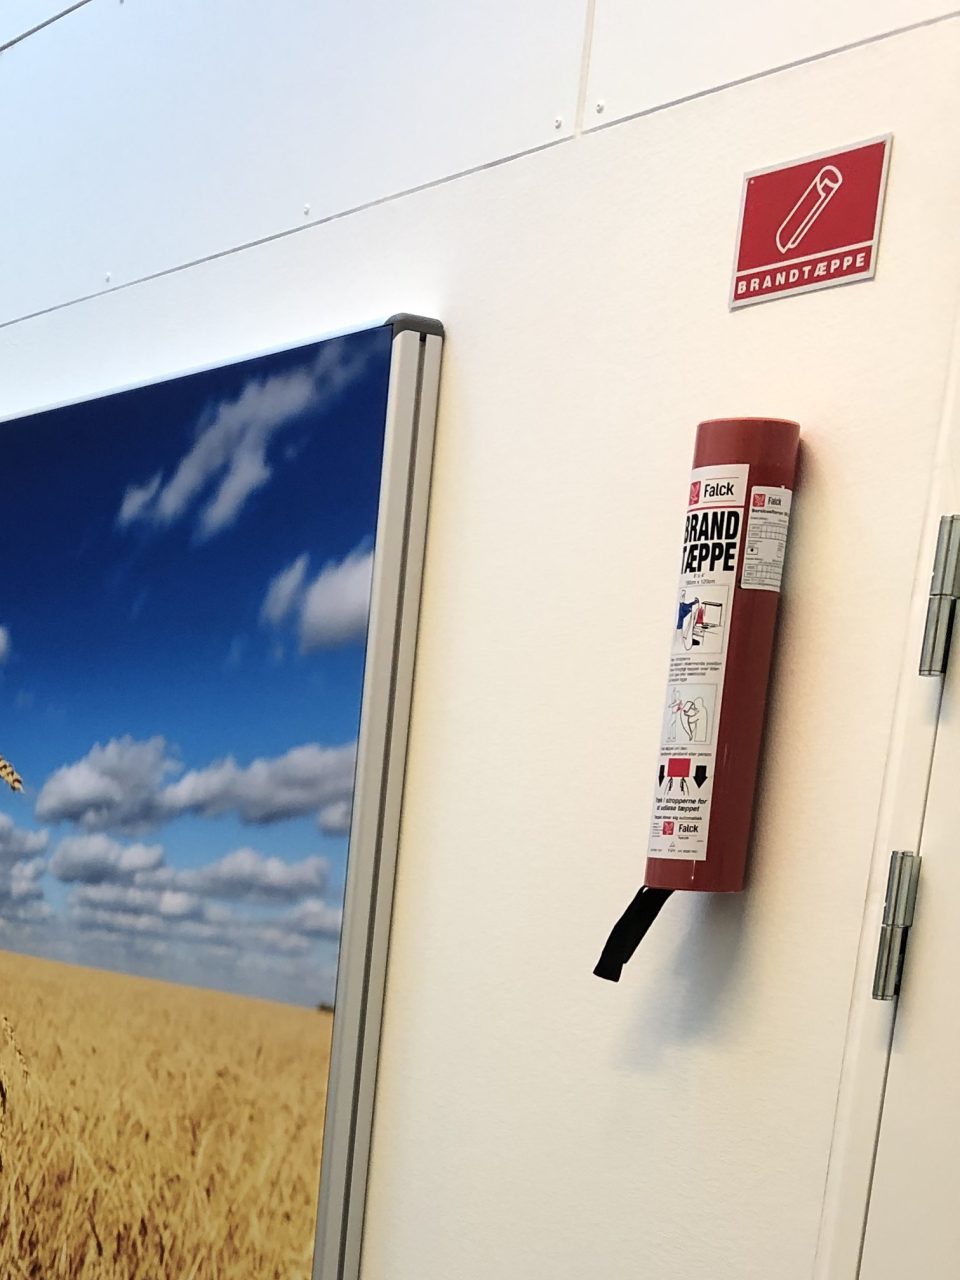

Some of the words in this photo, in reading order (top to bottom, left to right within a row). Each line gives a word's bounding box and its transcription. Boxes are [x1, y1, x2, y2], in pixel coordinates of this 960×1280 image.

[737, 253, 866, 295] BRANDTÆPPE
[704, 482, 734, 498] Falck
[678, 823, 699, 833] Falck
